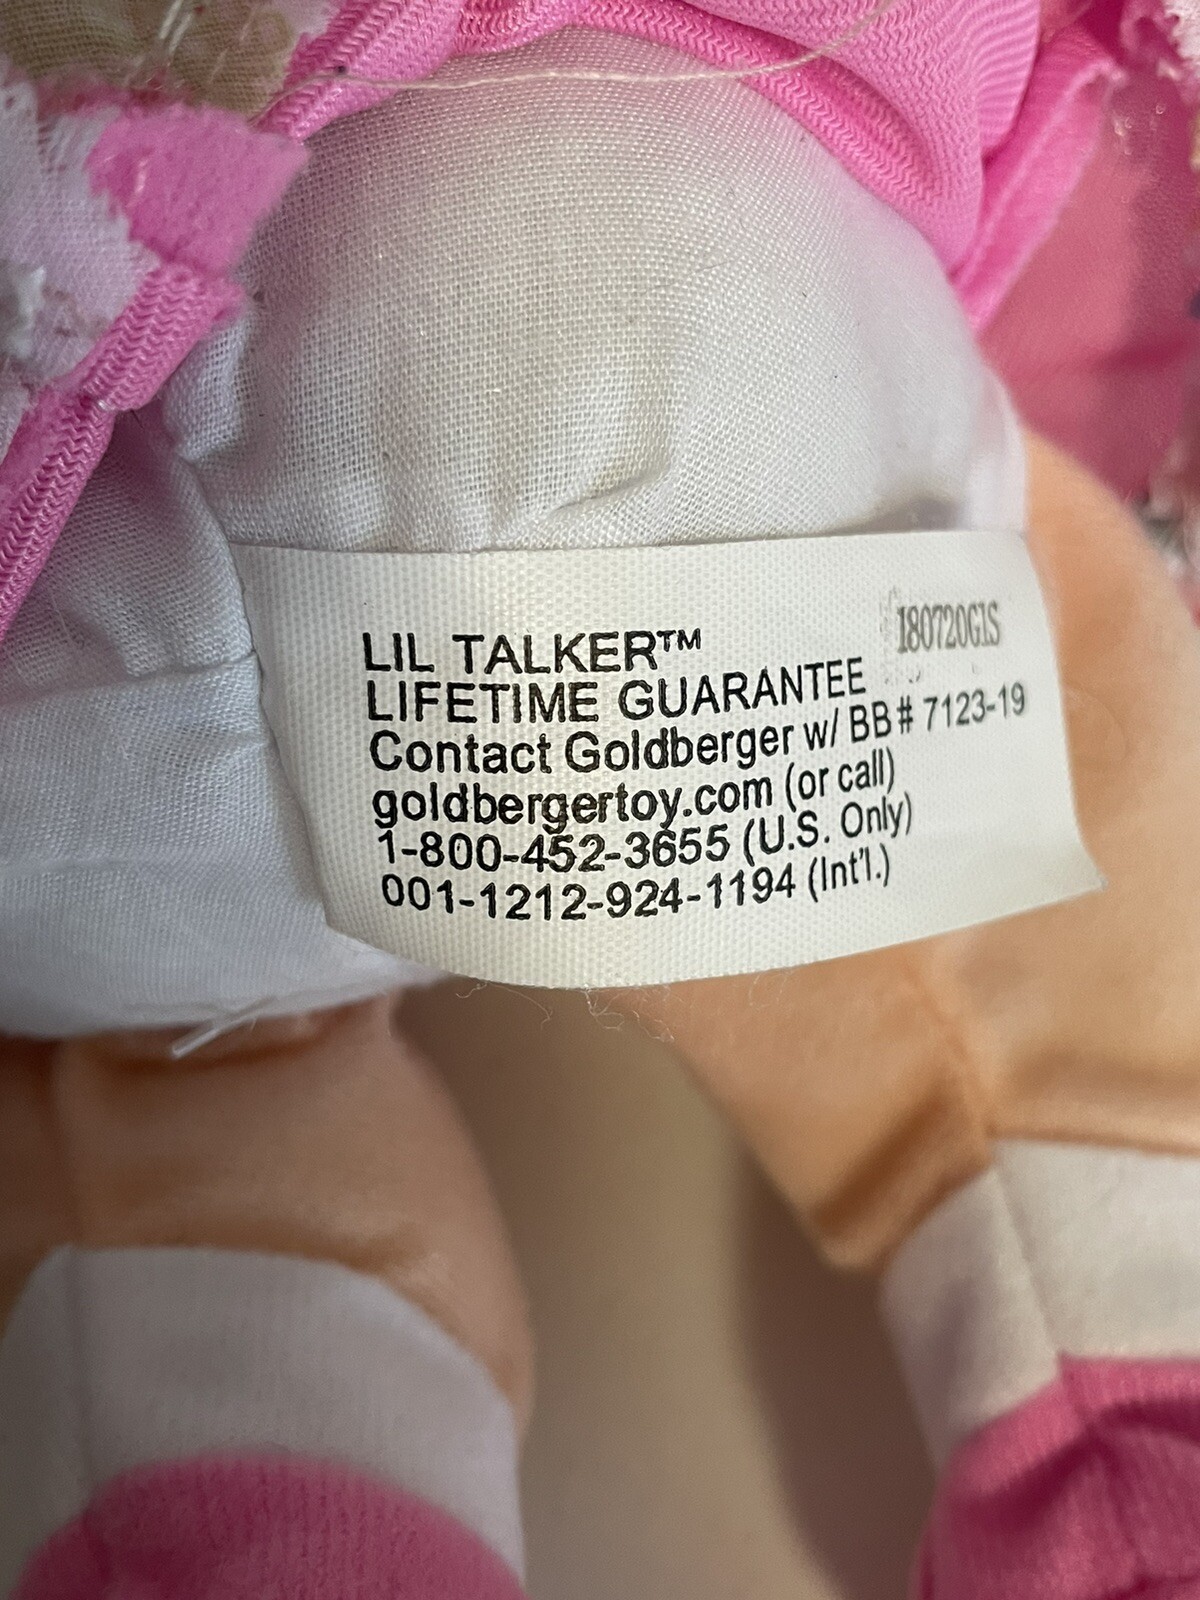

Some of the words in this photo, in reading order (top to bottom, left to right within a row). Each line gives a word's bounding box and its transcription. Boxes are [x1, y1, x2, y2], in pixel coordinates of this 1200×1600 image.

[362, 632, 435, 673] LIL
[367, 679, 599, 723] LIFETIME
[617, 657, 866, 721] GUARANTEE
[369, 729, 552, 774] Contact
[564, 724, 795, 773] Goldberger
[803, 707, 839, 751] w/
[922, 682, 1026, 732] 7123-19
[372, 776, 773, 834] goldbergertoy.com
[785, 762, 829, 813] (or
[837, 746, 895, 795] call)
[378, 823, 731, 873] 1-800-452-3655
[743, 810, 830, 867] (U.S.
[840, 791, 912, 839] Only)
[381, 863, 796, 921] 001-1212-924-1194
